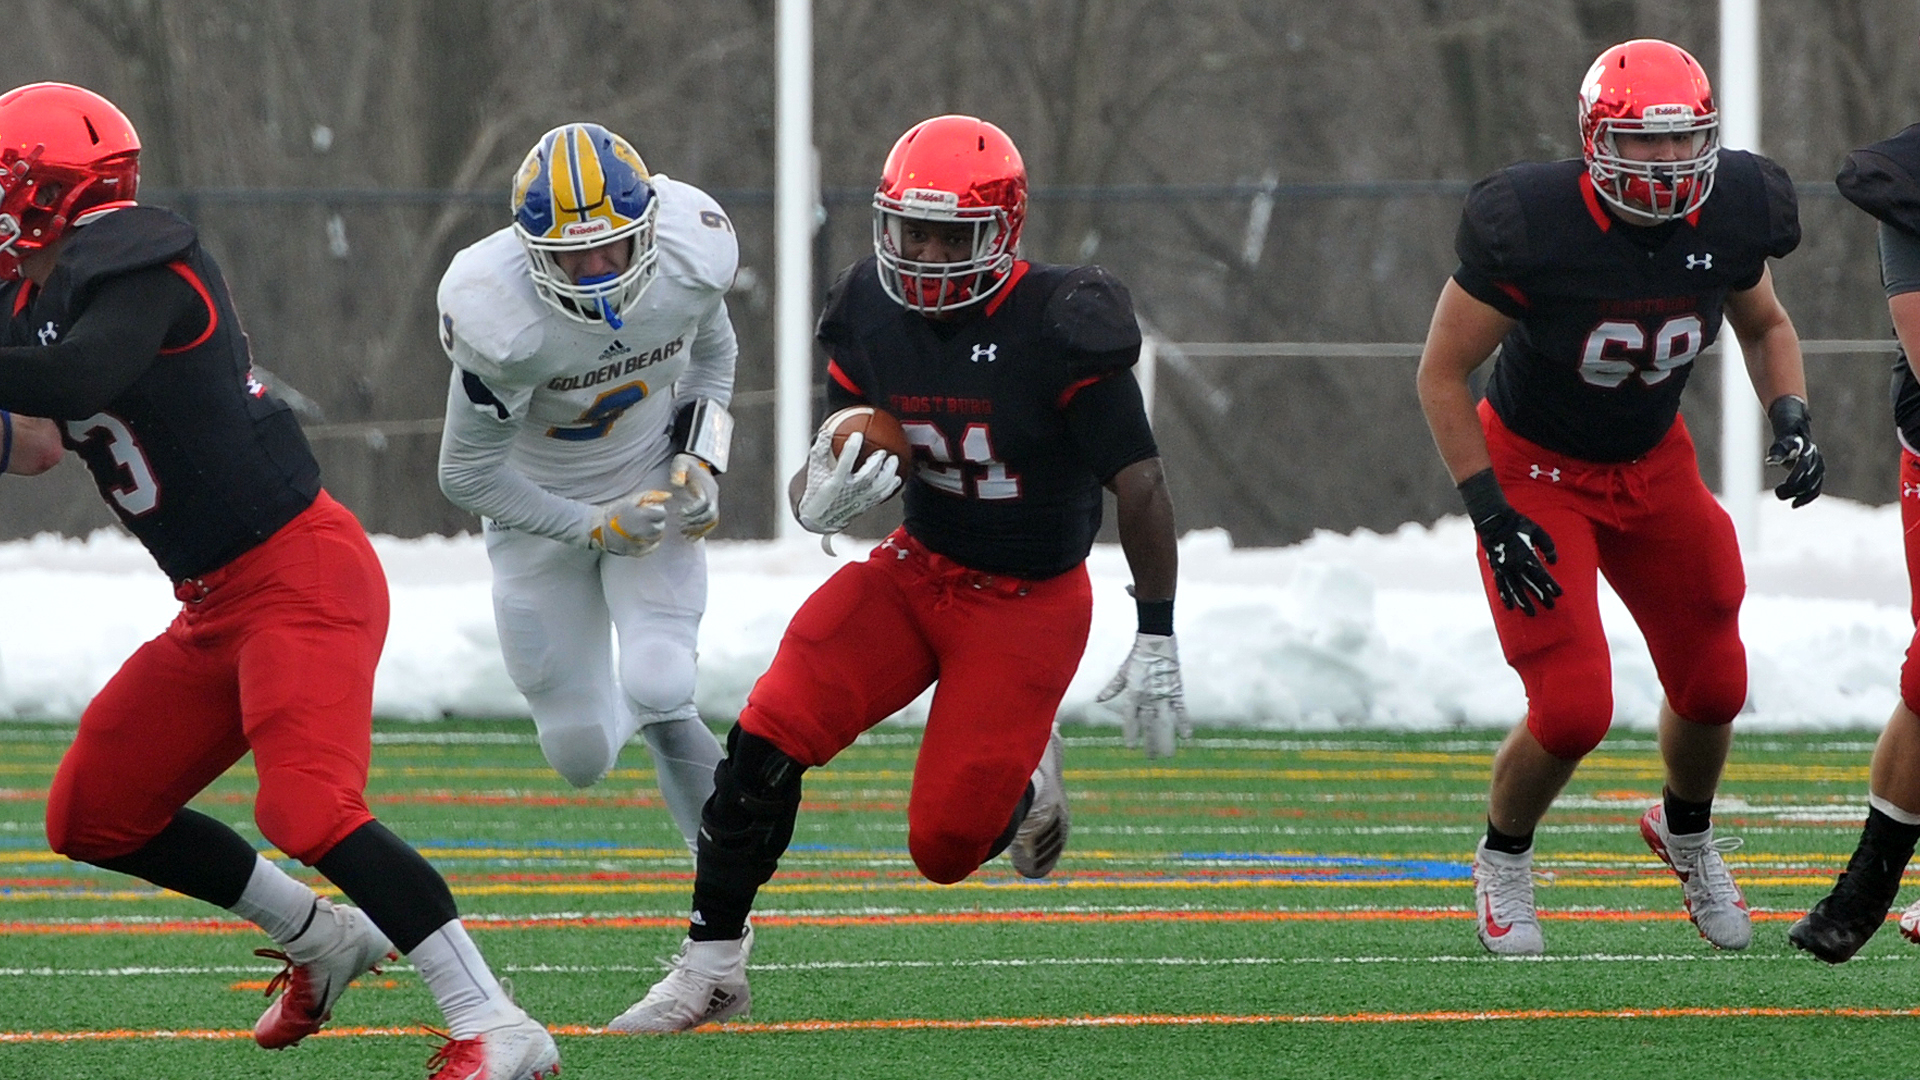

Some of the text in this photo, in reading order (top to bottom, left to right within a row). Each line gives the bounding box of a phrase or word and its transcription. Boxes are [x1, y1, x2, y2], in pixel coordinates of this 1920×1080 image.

[1654, 106, 1682, 115] Riddell
[914, 191, 945, 202] Riddell
[568, 223, 605, 235] Riddell
[547, 332, 685, 391] GOLDEN BEARS
[1577, 312, 1704, 389] 69
[900, 419, 1023, 501] 21
